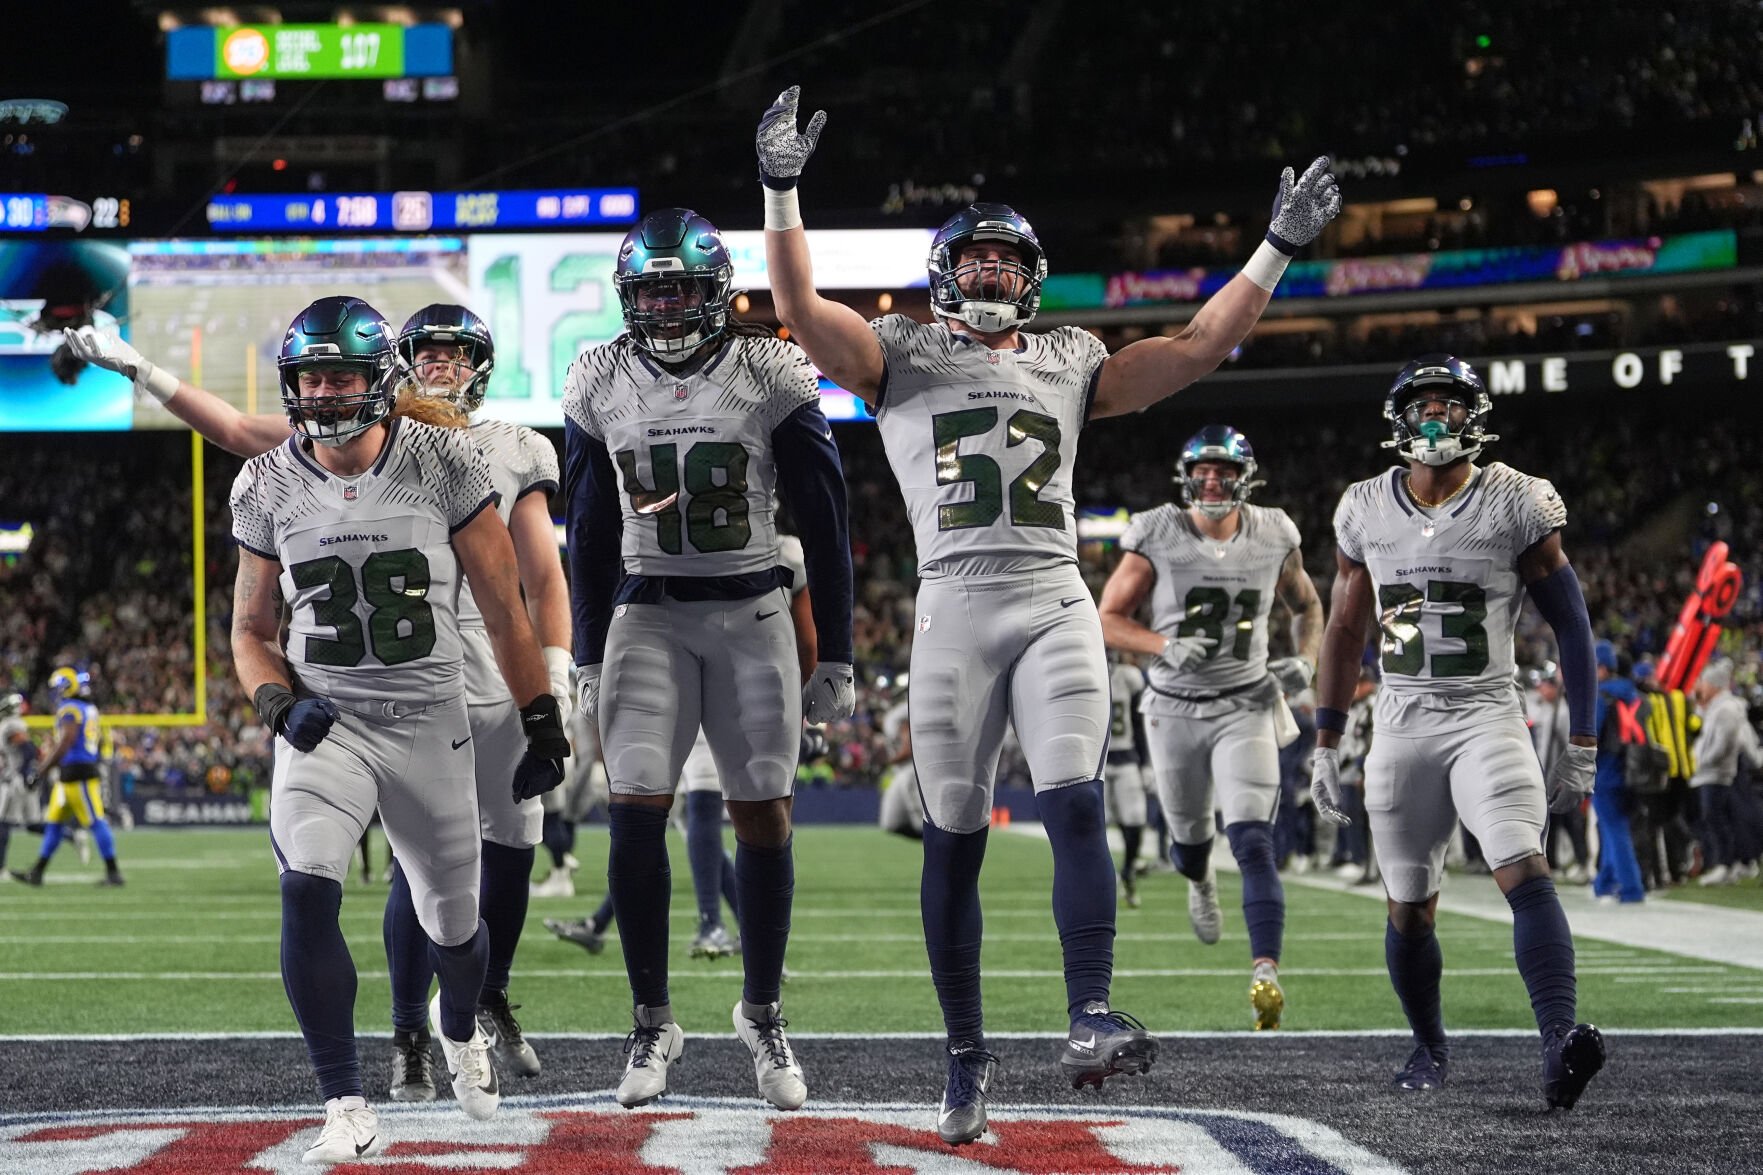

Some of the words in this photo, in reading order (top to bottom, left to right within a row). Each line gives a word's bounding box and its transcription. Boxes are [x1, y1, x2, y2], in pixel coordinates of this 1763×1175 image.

[93, 197, 119, 228] 22
[484, 252, 622, 399] 12
[1612, 349, 1682, 389] OF
[1726, 344, 1755, 380] T
[968, 391, 1035, 403] SEAHAWKS
[647, 425, 716, 437] SEAHAWKS
[615, 441, 752, 556] 48
[932, 405, 1066, 532] 52
[319, 533, 389, 547] SEAHAWKS
[1395, 565, 1453, 577] SEAHAWKS
[289, 547, 437, 668] 38
[1177, 586, 1262, 661] 81
[1378, 579, 1490, 678] 83
